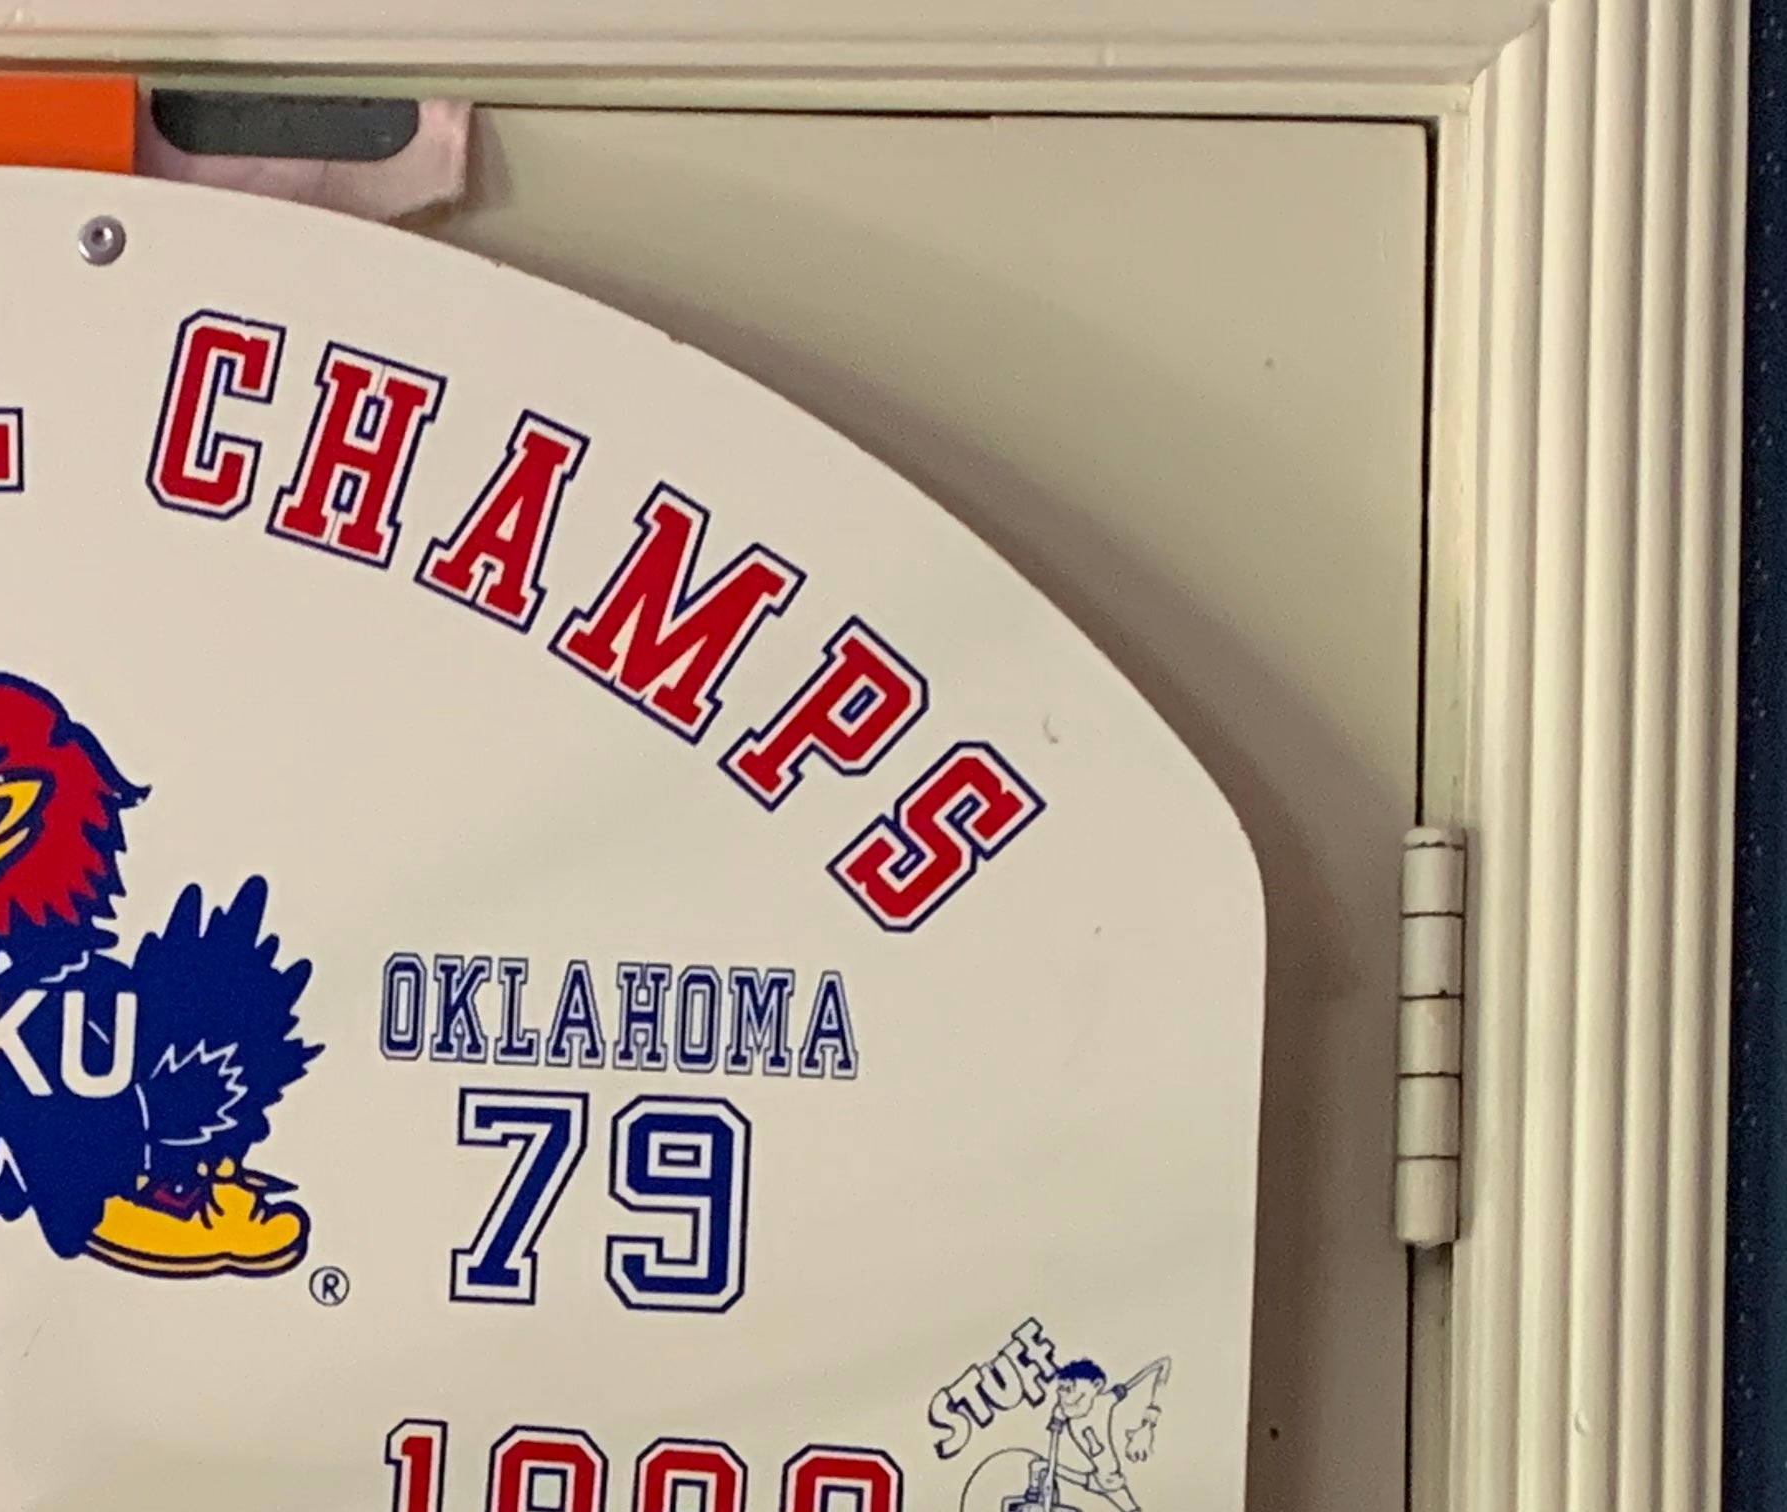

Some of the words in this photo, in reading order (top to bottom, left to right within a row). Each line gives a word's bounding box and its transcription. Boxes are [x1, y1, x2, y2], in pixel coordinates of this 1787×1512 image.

[145, 309, 1046, 932] CHAMPS
[379, 952, 859, 1079] OKLAHOMA
[449, 1087, 752, 1314] 79
[928, 1317, 1059, 1460] STUFF
